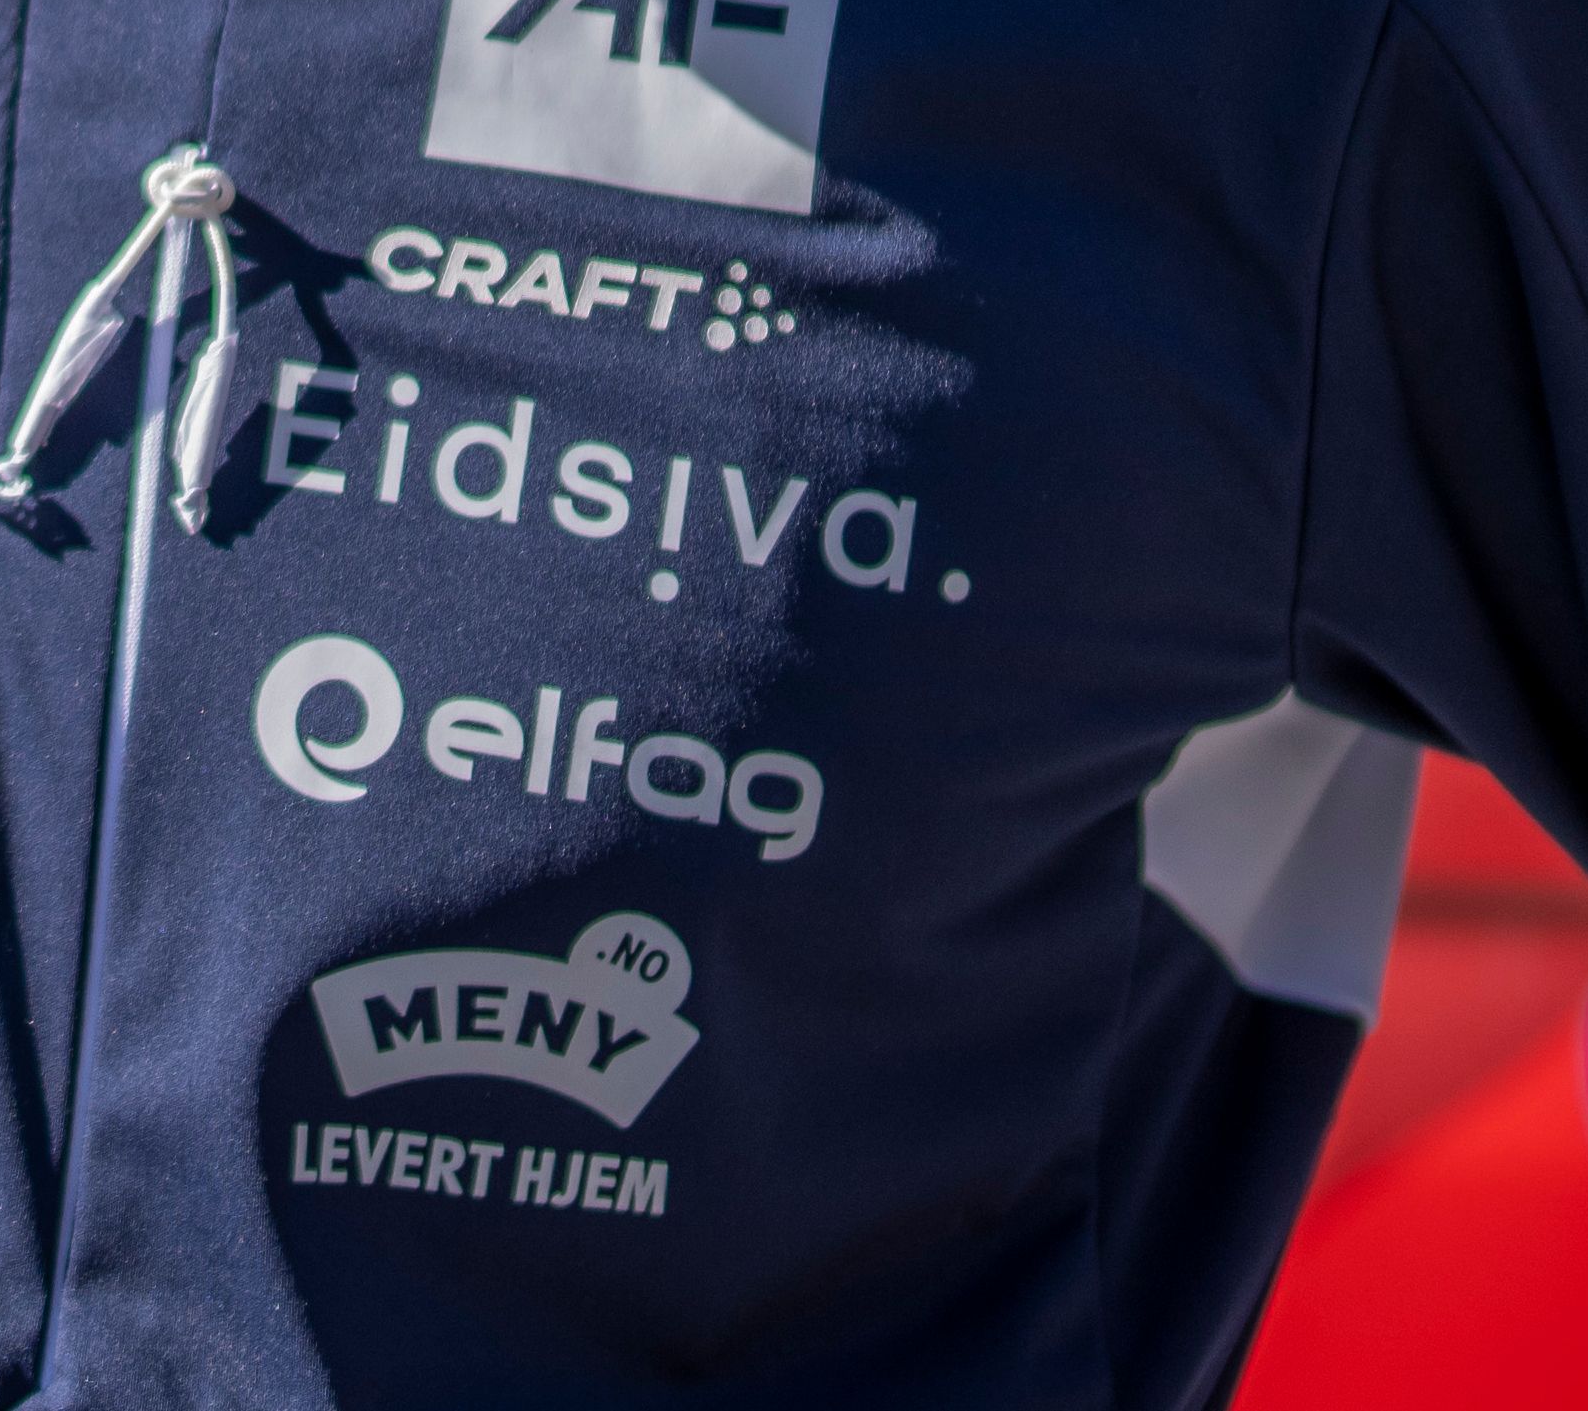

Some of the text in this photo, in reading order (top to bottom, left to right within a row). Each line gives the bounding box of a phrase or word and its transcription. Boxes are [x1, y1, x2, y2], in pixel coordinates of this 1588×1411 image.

[370, 226, 704, 332] CRAFT
[426, 686, 825, 862] elfag
[363, 984, 651, 1074] MENY
[292, 1121, 670, 1217] LEVERT HJEM
